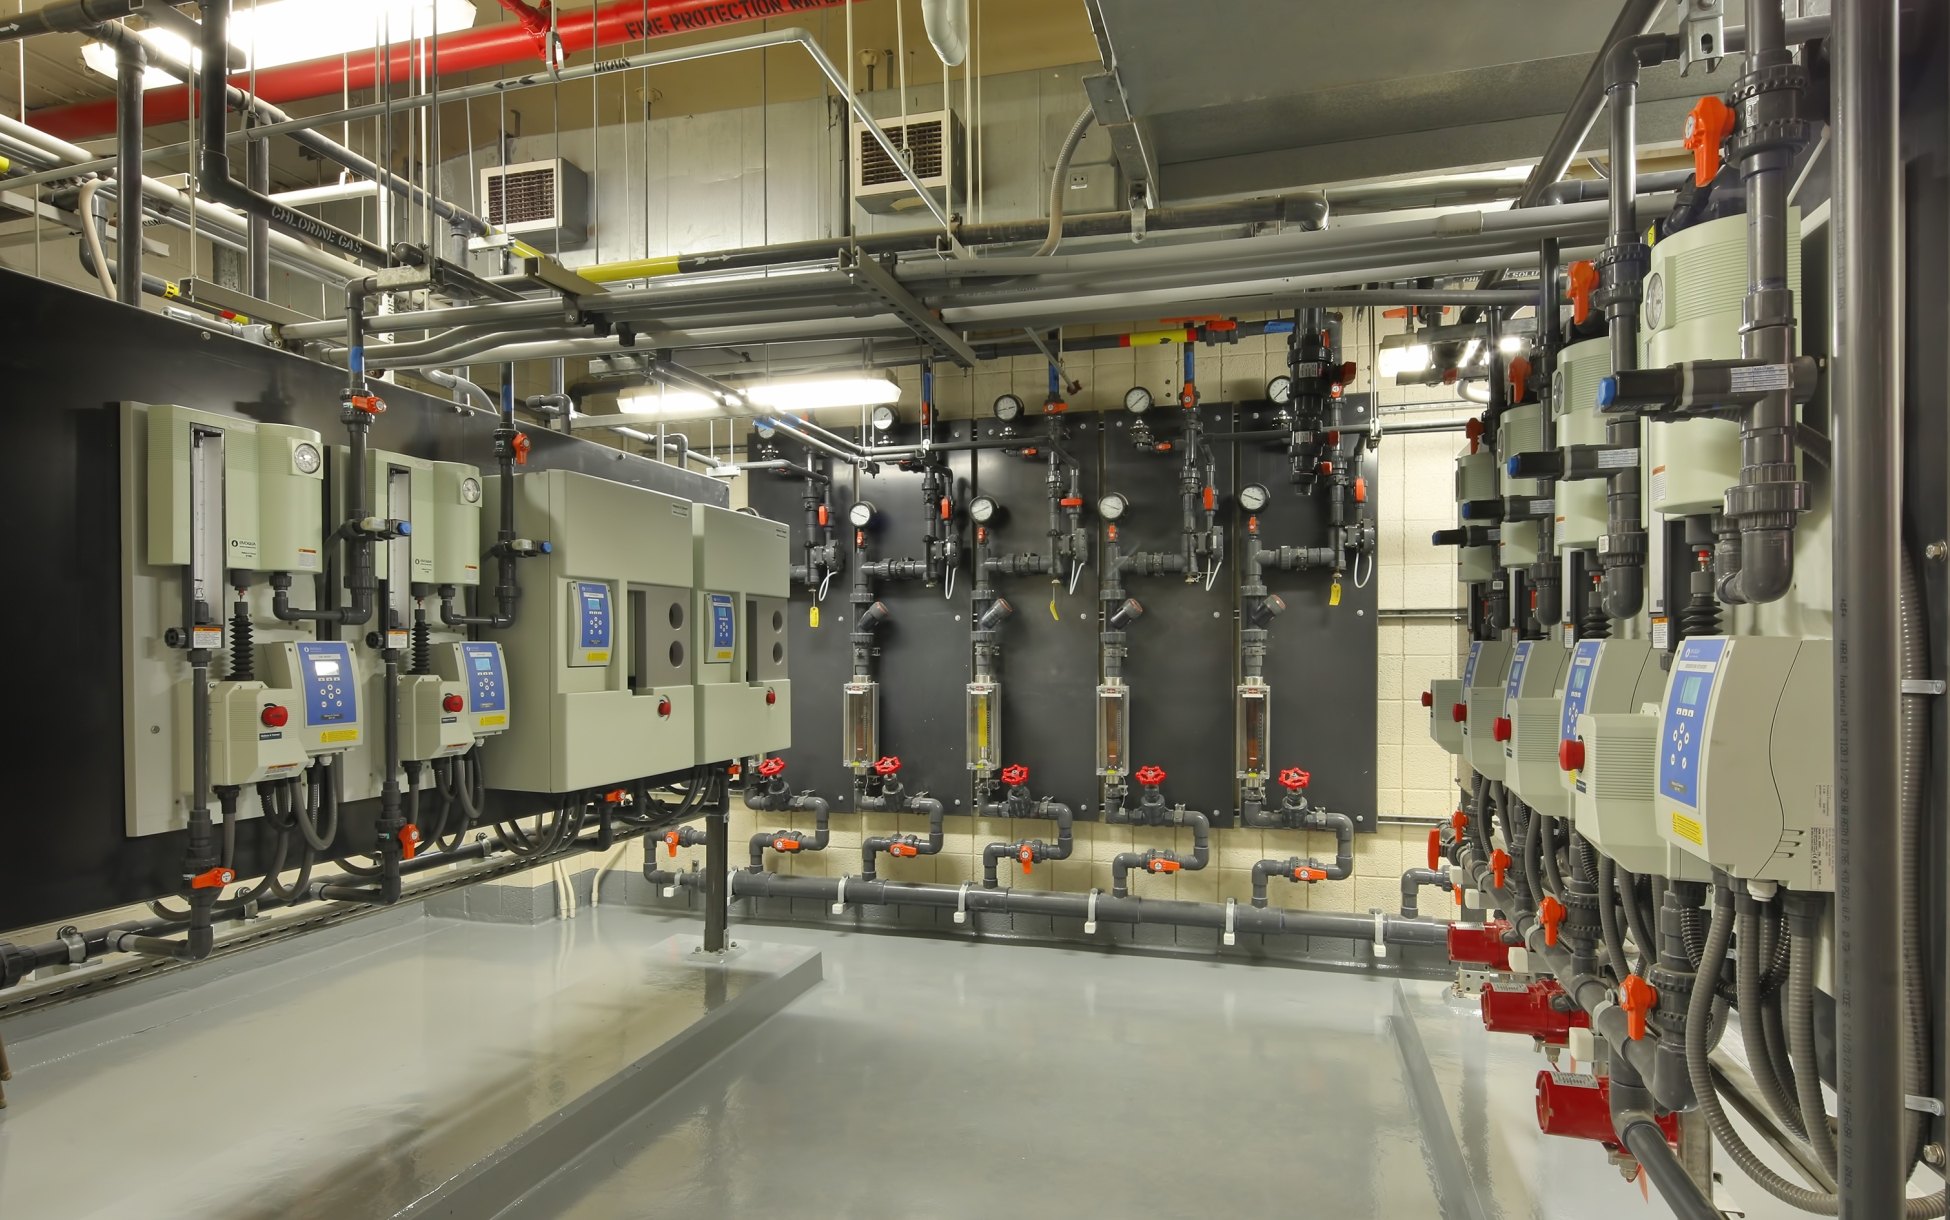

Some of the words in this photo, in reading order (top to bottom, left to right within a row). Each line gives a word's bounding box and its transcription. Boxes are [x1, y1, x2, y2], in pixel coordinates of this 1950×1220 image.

[625, 16, 669, 39] FIRE
[669, 0, 784, 32] PROTECTION
[594, 57, 631, 72] DRAIN
[271, 204, 337, 243] CHLORINE
[338, 235, 363, 254] GAS
